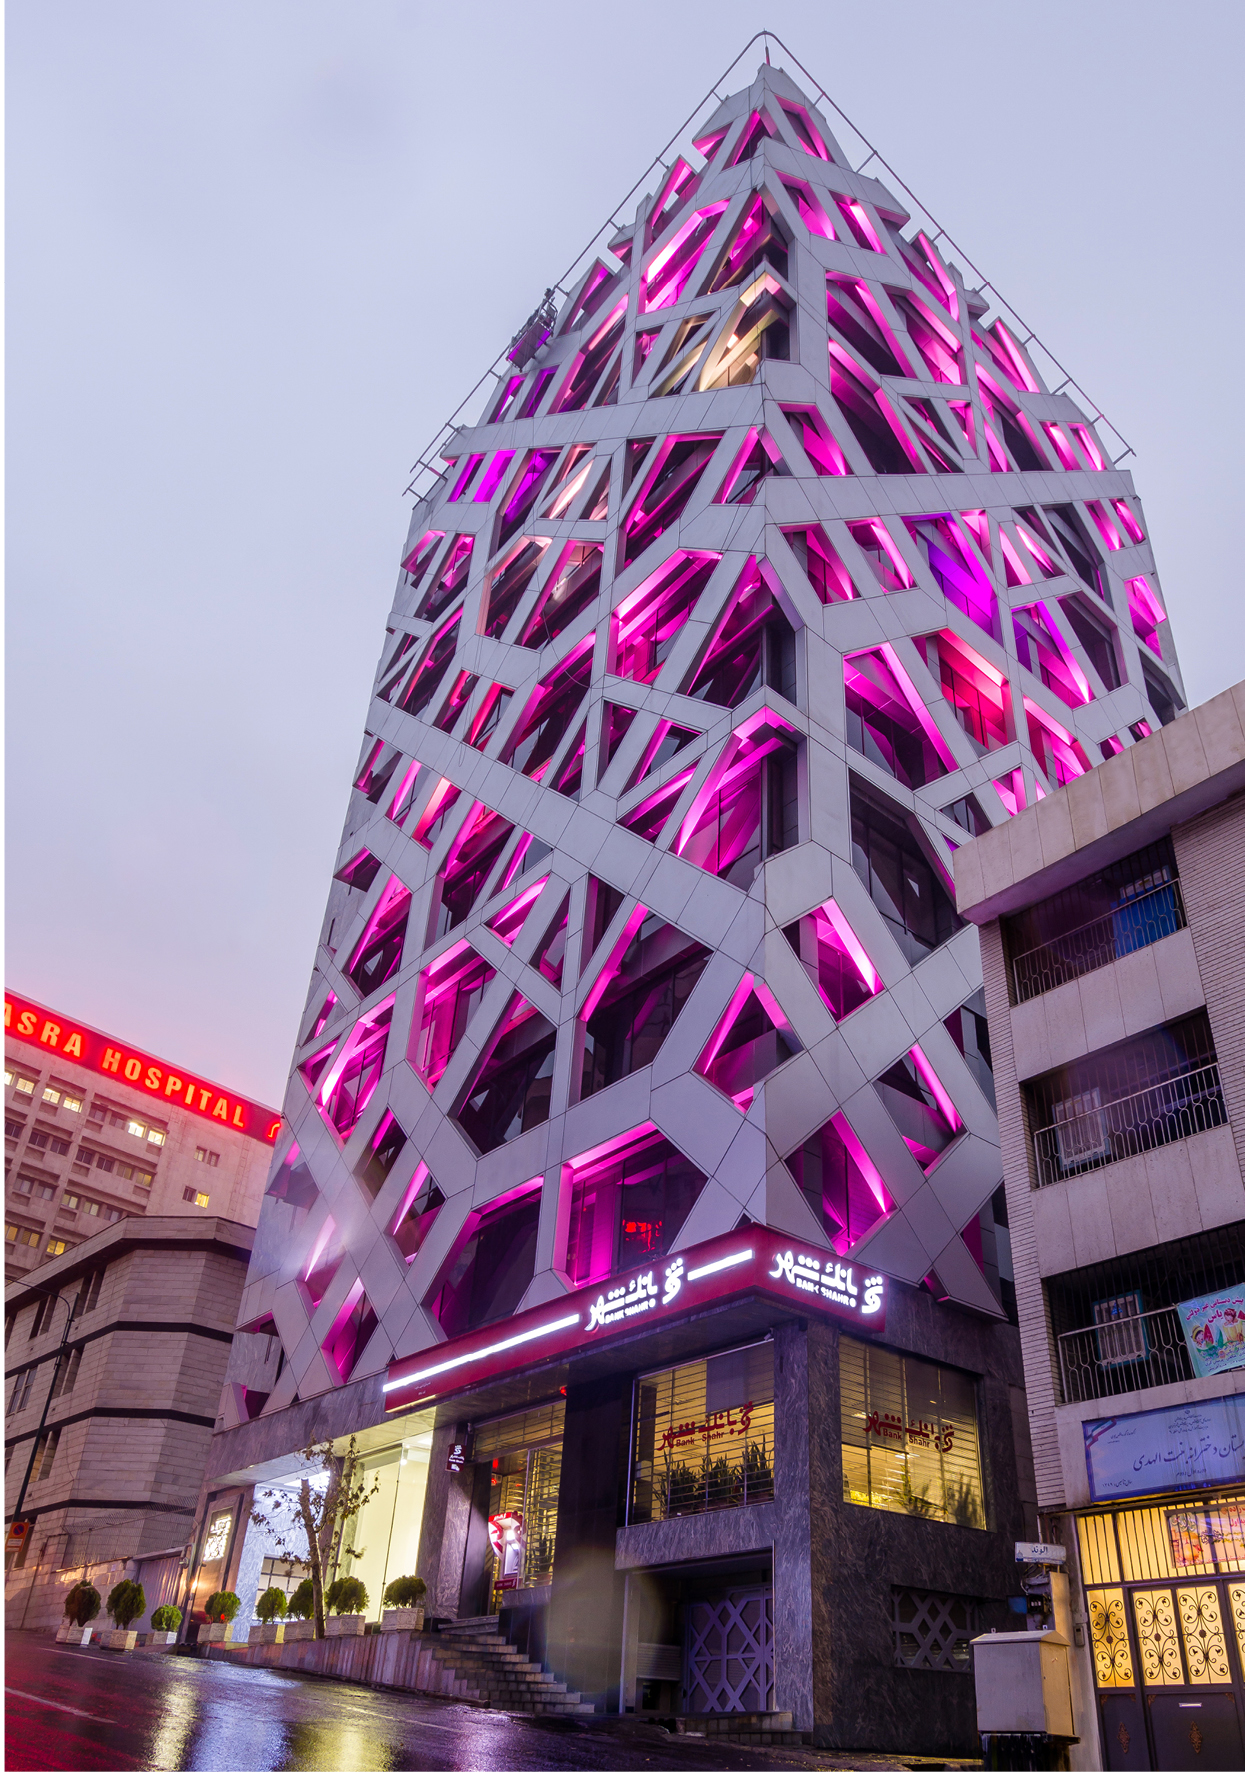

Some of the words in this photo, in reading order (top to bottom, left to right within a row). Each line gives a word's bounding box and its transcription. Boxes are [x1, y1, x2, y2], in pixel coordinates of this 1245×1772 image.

[102, 1048, 245, 1128] HOSPITAL
[769, 1251, 820, 1284] شهر
[796, 1278, 820, 1294] BANK
[820, 1287, 850, 1306] SHAHR
[584, 1287, 626, 1331] شهر
[1186, 1307, 1200, 1321] دولتی
[1207, 1308, 1223, 1323] یاس
[698, 1410, 737, 1435] بانک
[862, 1410, 902, 1433] شهر
[657, 1421, 696, 1451] شهر
[676, 1437, 695, 1447] Bank
[702, 1430, 725, 1444] Shahr
[883, 1429, 902, 1441] Bank
[909, 1435, 931, 1448] Shahr
[1031, 1545, 1048, 1555] الوند
